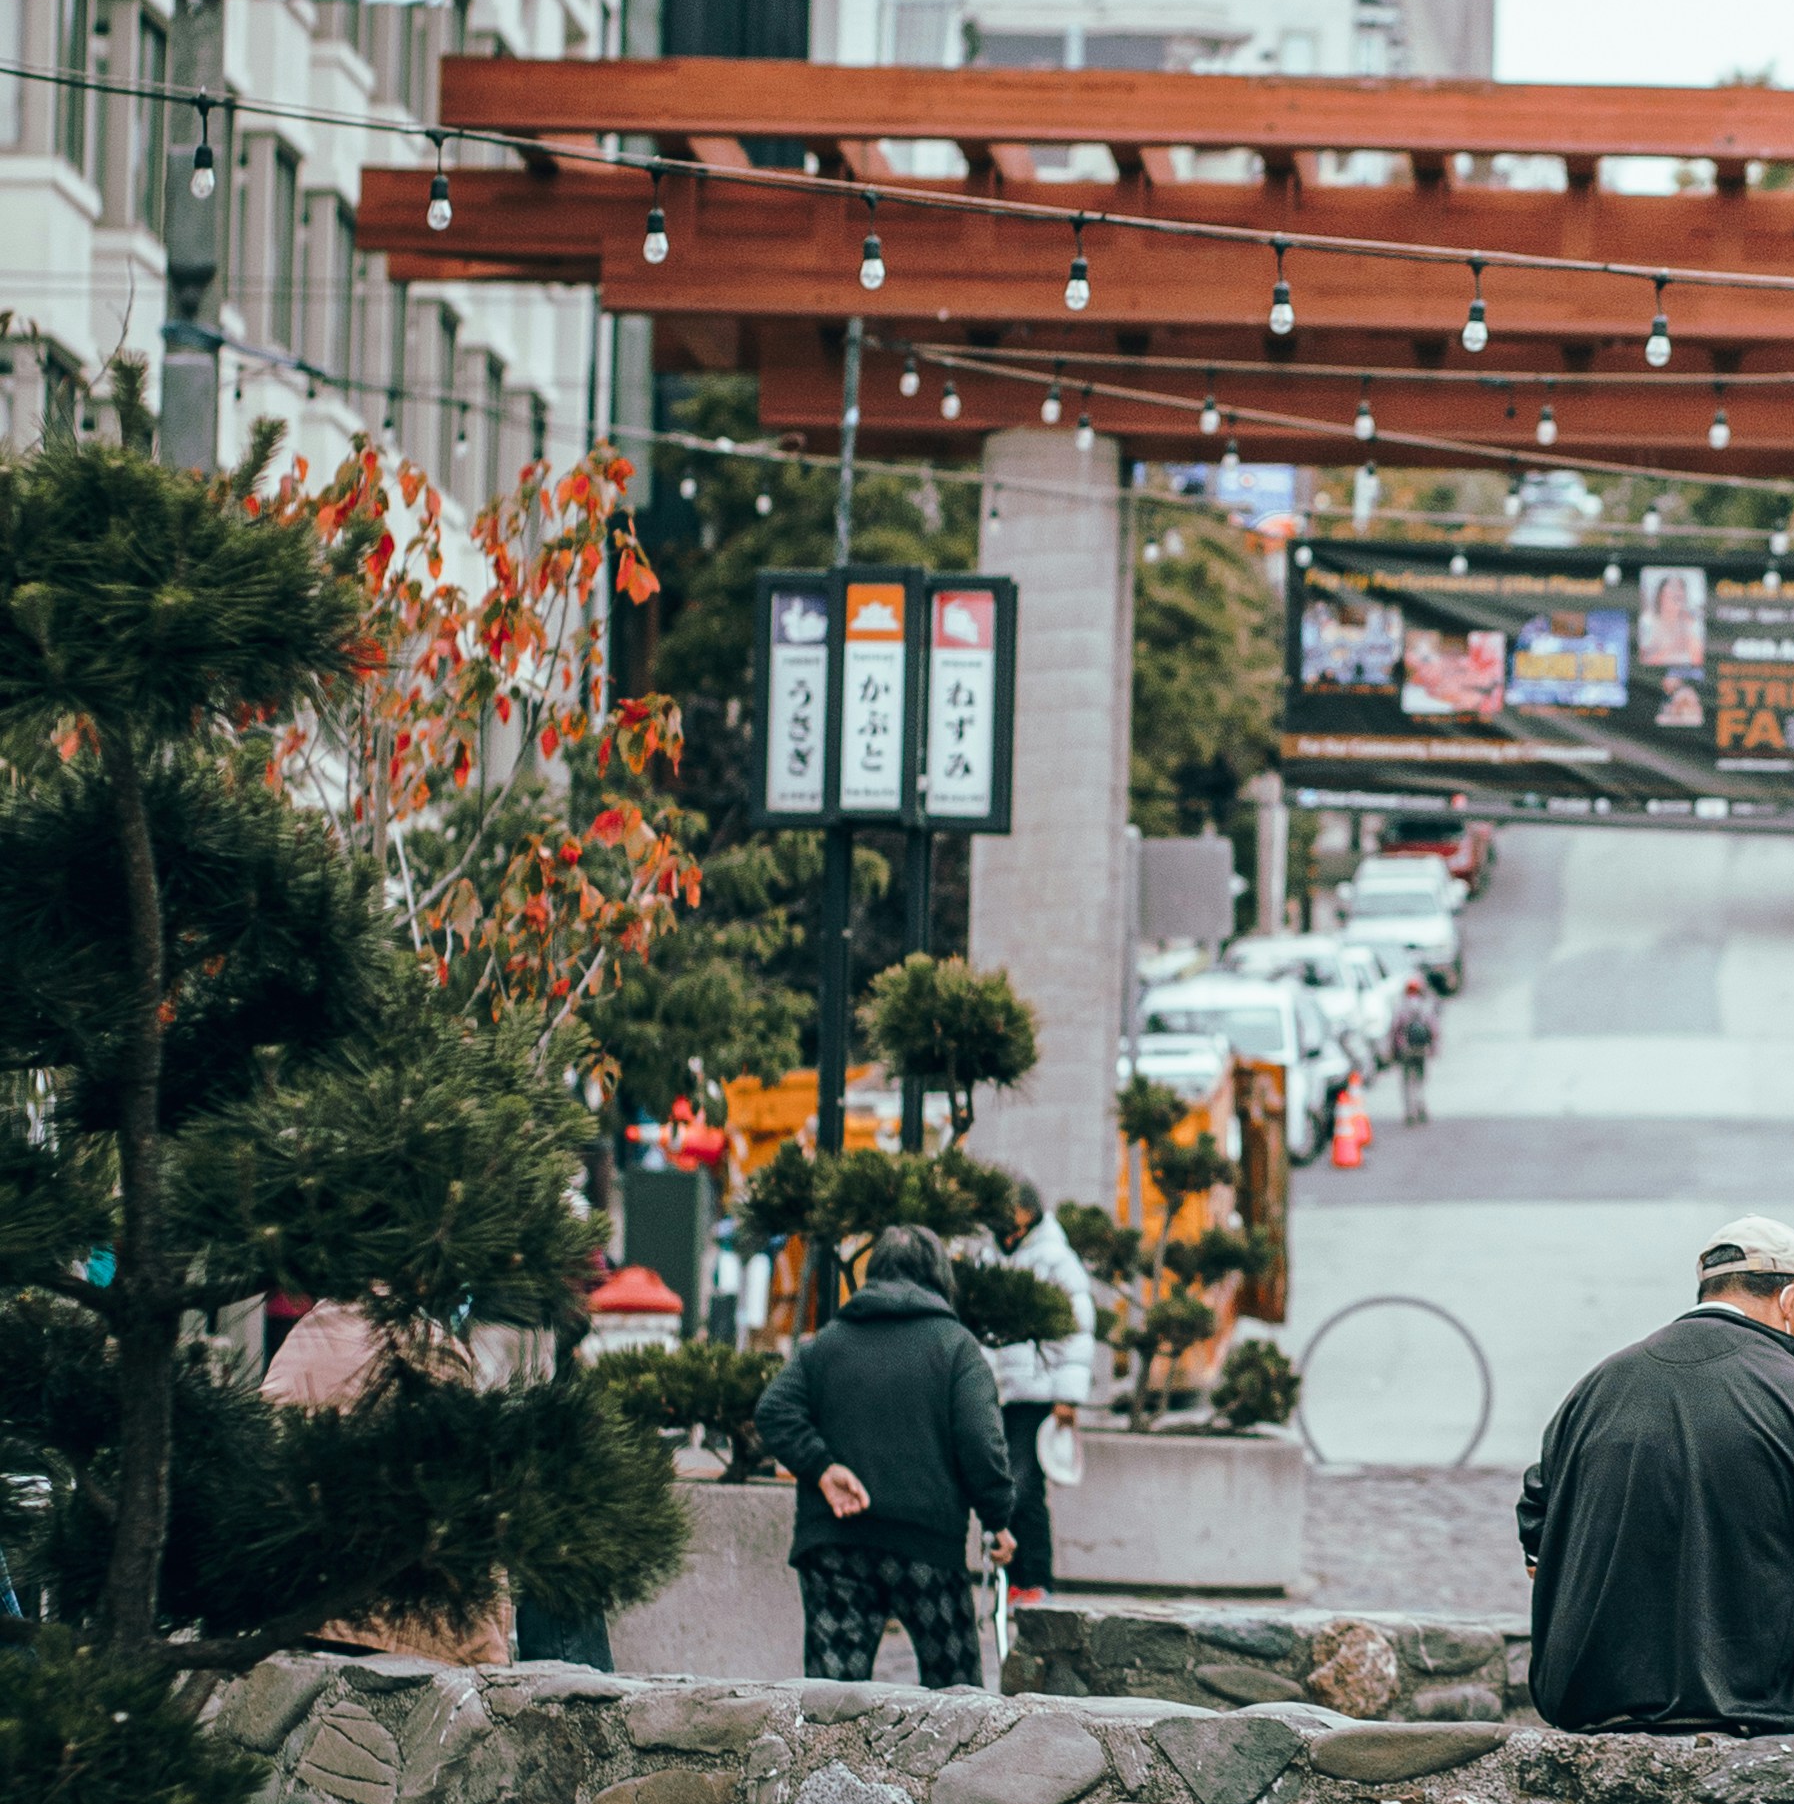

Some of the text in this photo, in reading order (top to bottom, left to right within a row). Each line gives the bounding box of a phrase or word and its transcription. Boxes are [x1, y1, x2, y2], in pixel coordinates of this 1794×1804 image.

[786, 680, 814, 777] うさぎ
[858, 674, 890, 772] かぶと
[944, 680, 976, 779] ねずみ
